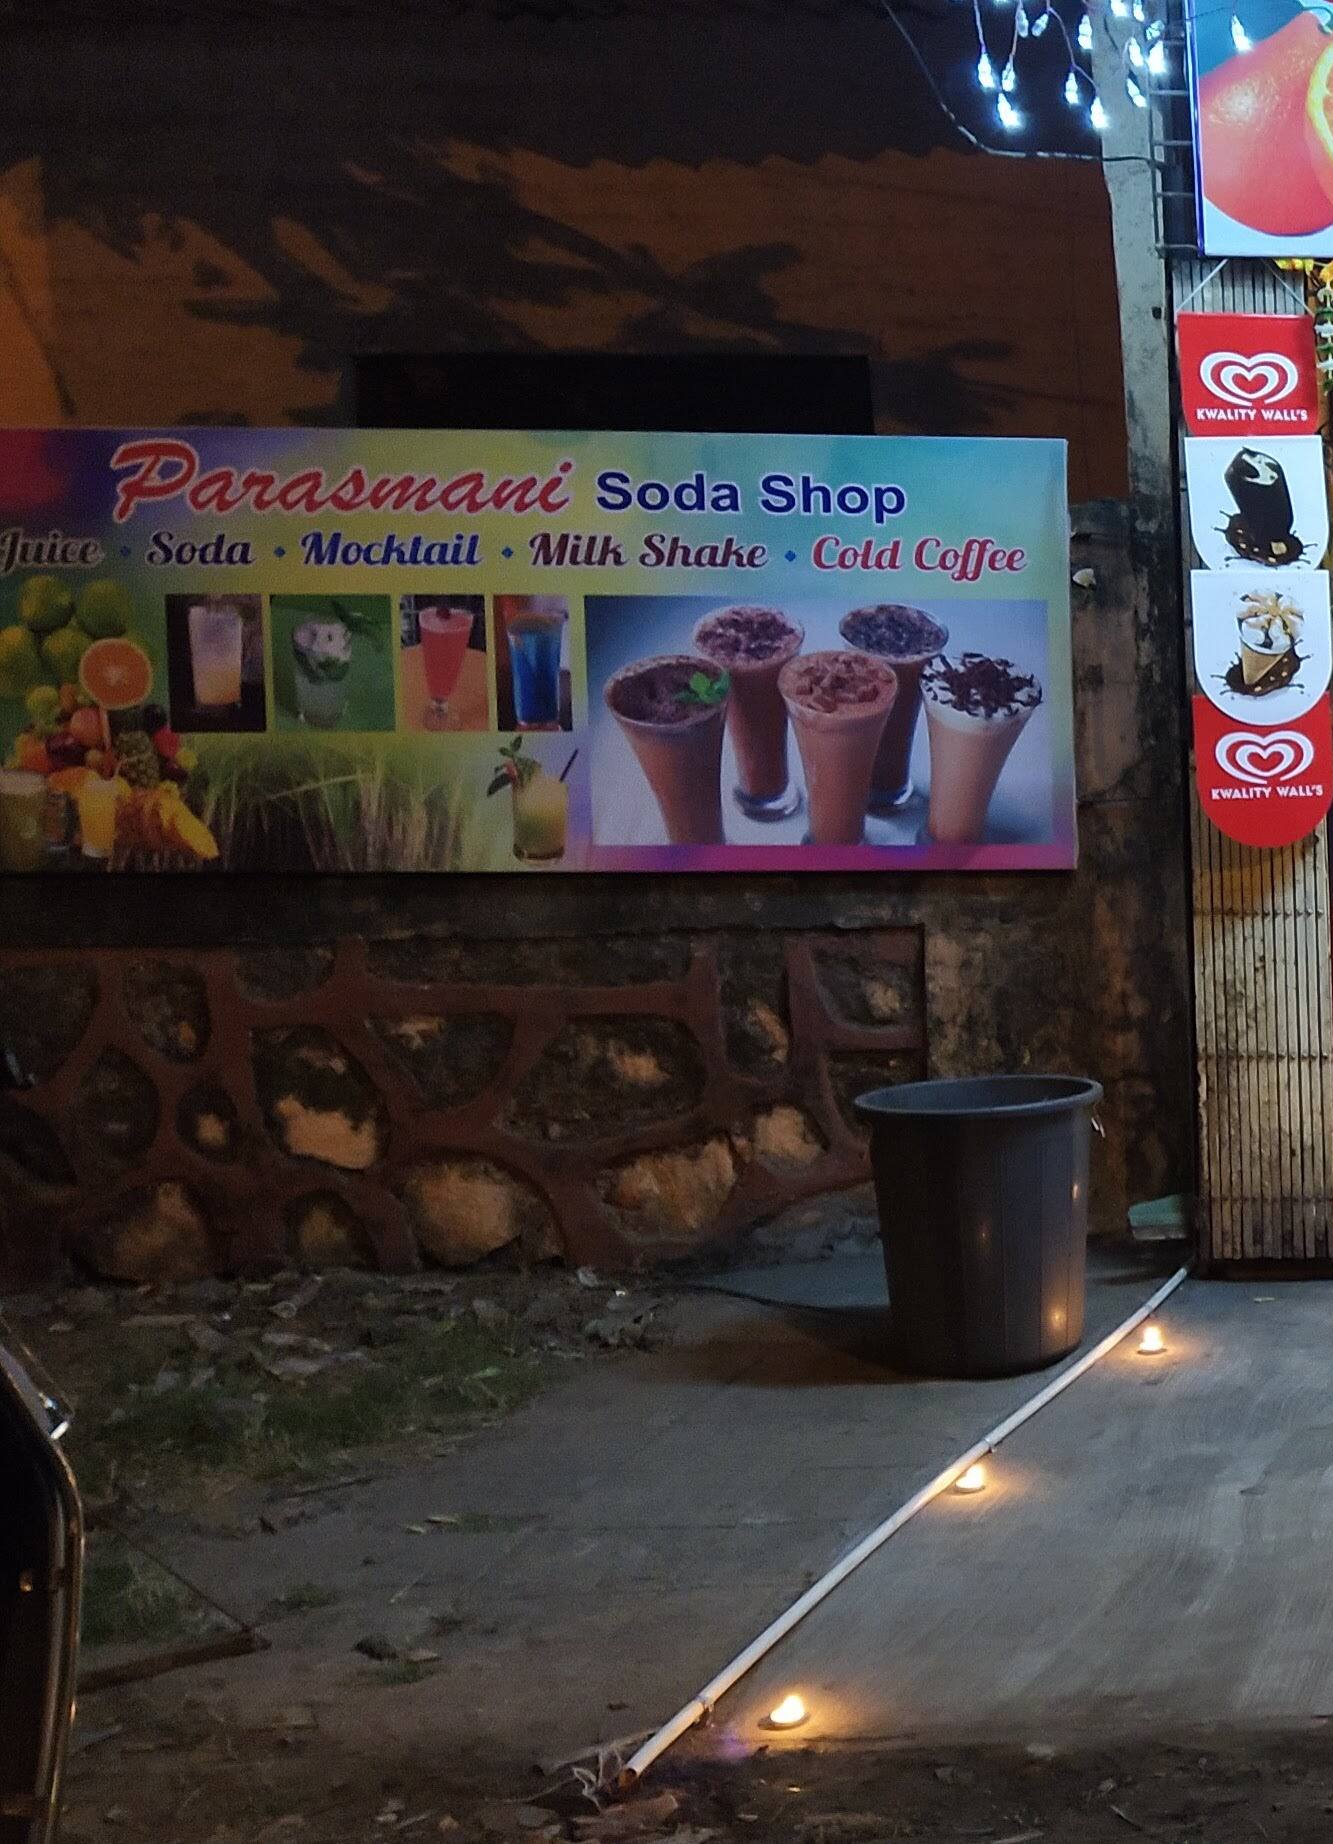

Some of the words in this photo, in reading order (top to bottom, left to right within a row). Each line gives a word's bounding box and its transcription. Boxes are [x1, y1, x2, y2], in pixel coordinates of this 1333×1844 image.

[1196, 408, 1257, 421] KWALITY
[1260, 408, 1308, 421] WALL'S
[111, 440, 573, 522] Parasmani
[596, 471, 741, 512] Soda
[760, 474, 906, 523] Shop
[0, 529, 102, 572] Juice
[147, 531, 254, 567] Soda
[301, 531, 483, 567] Mocktail
[529, 532, 627, 568] Milk
[638, 533, 769, 569] Shake
[811, 535, 903, 571] Cold
[913, 537, 1028, 582] Coffee
[1211, 786, 1271, 800] KWALITY
[1276, 784, 1323, 797] WALL'S
